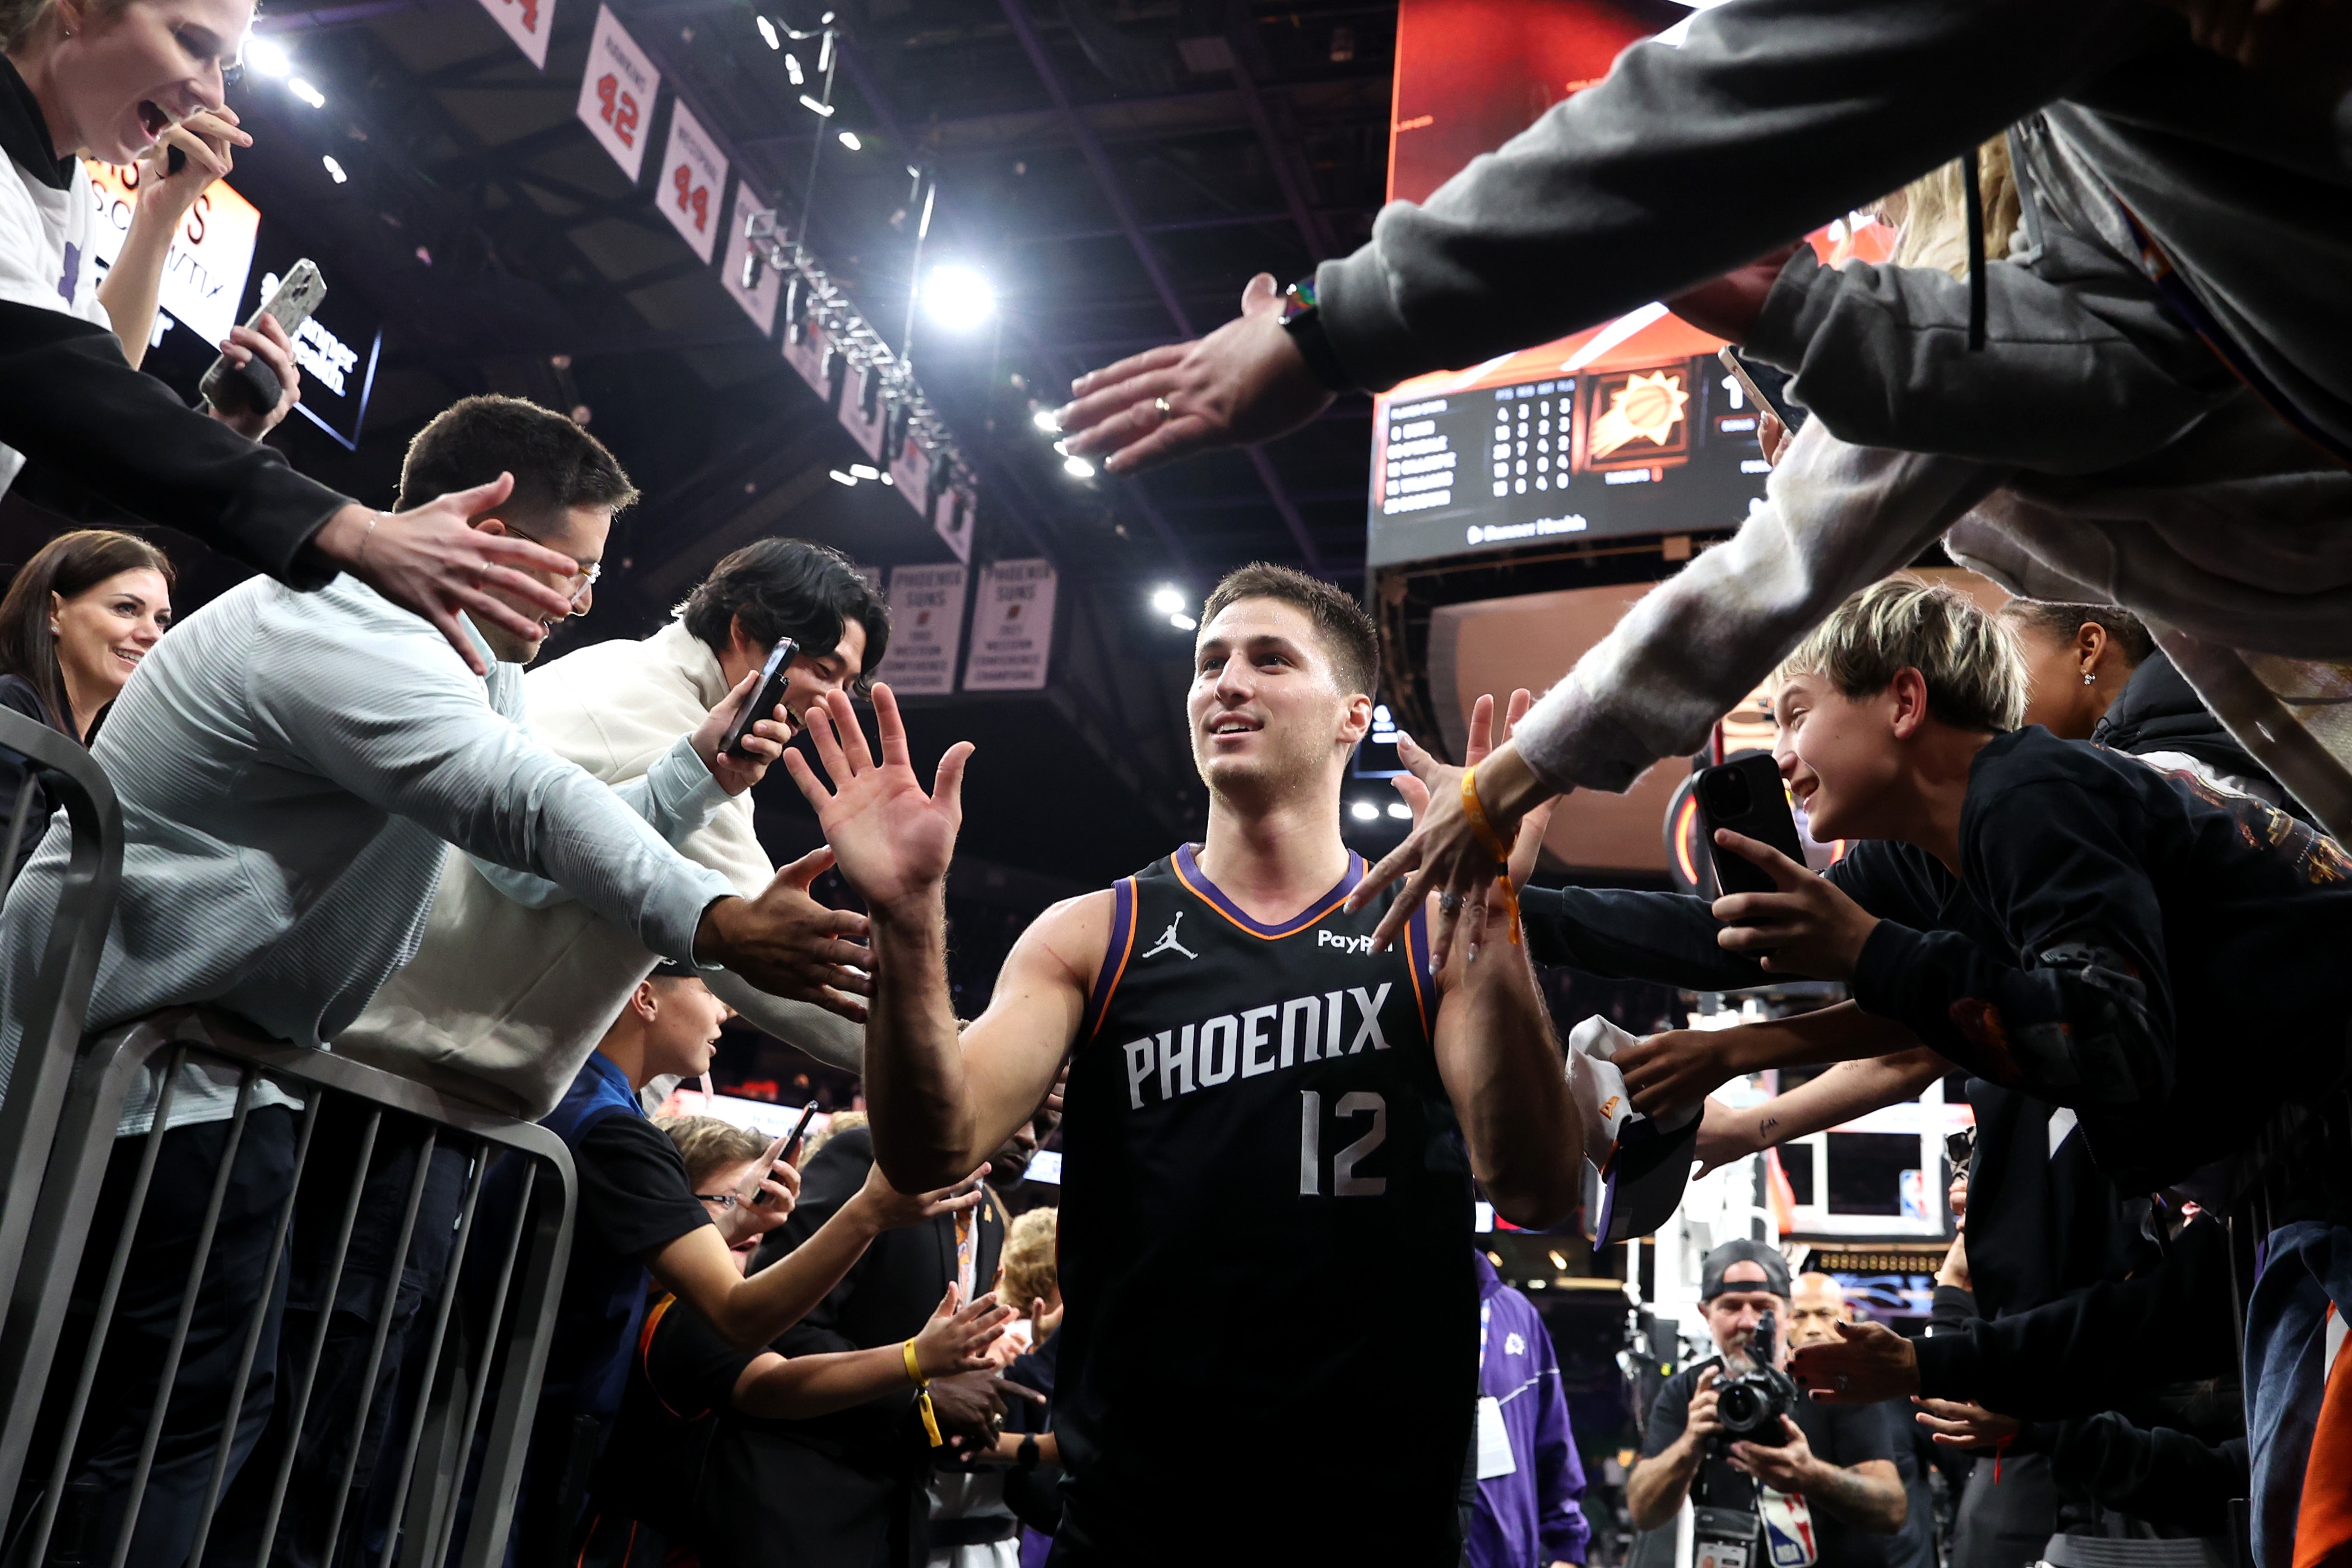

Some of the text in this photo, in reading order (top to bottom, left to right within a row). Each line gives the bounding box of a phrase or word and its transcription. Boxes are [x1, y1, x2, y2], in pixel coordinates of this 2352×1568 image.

[597, 73, 638, 149] 42
[675, 165, 708, 233] 44
[298, 315, 359, 374] anner
[1318, 929, 1393, 954] PayP
[1122, 982, 1392, 1110] PHOENIX
[1300, 1089, 1387, 1196] 12
